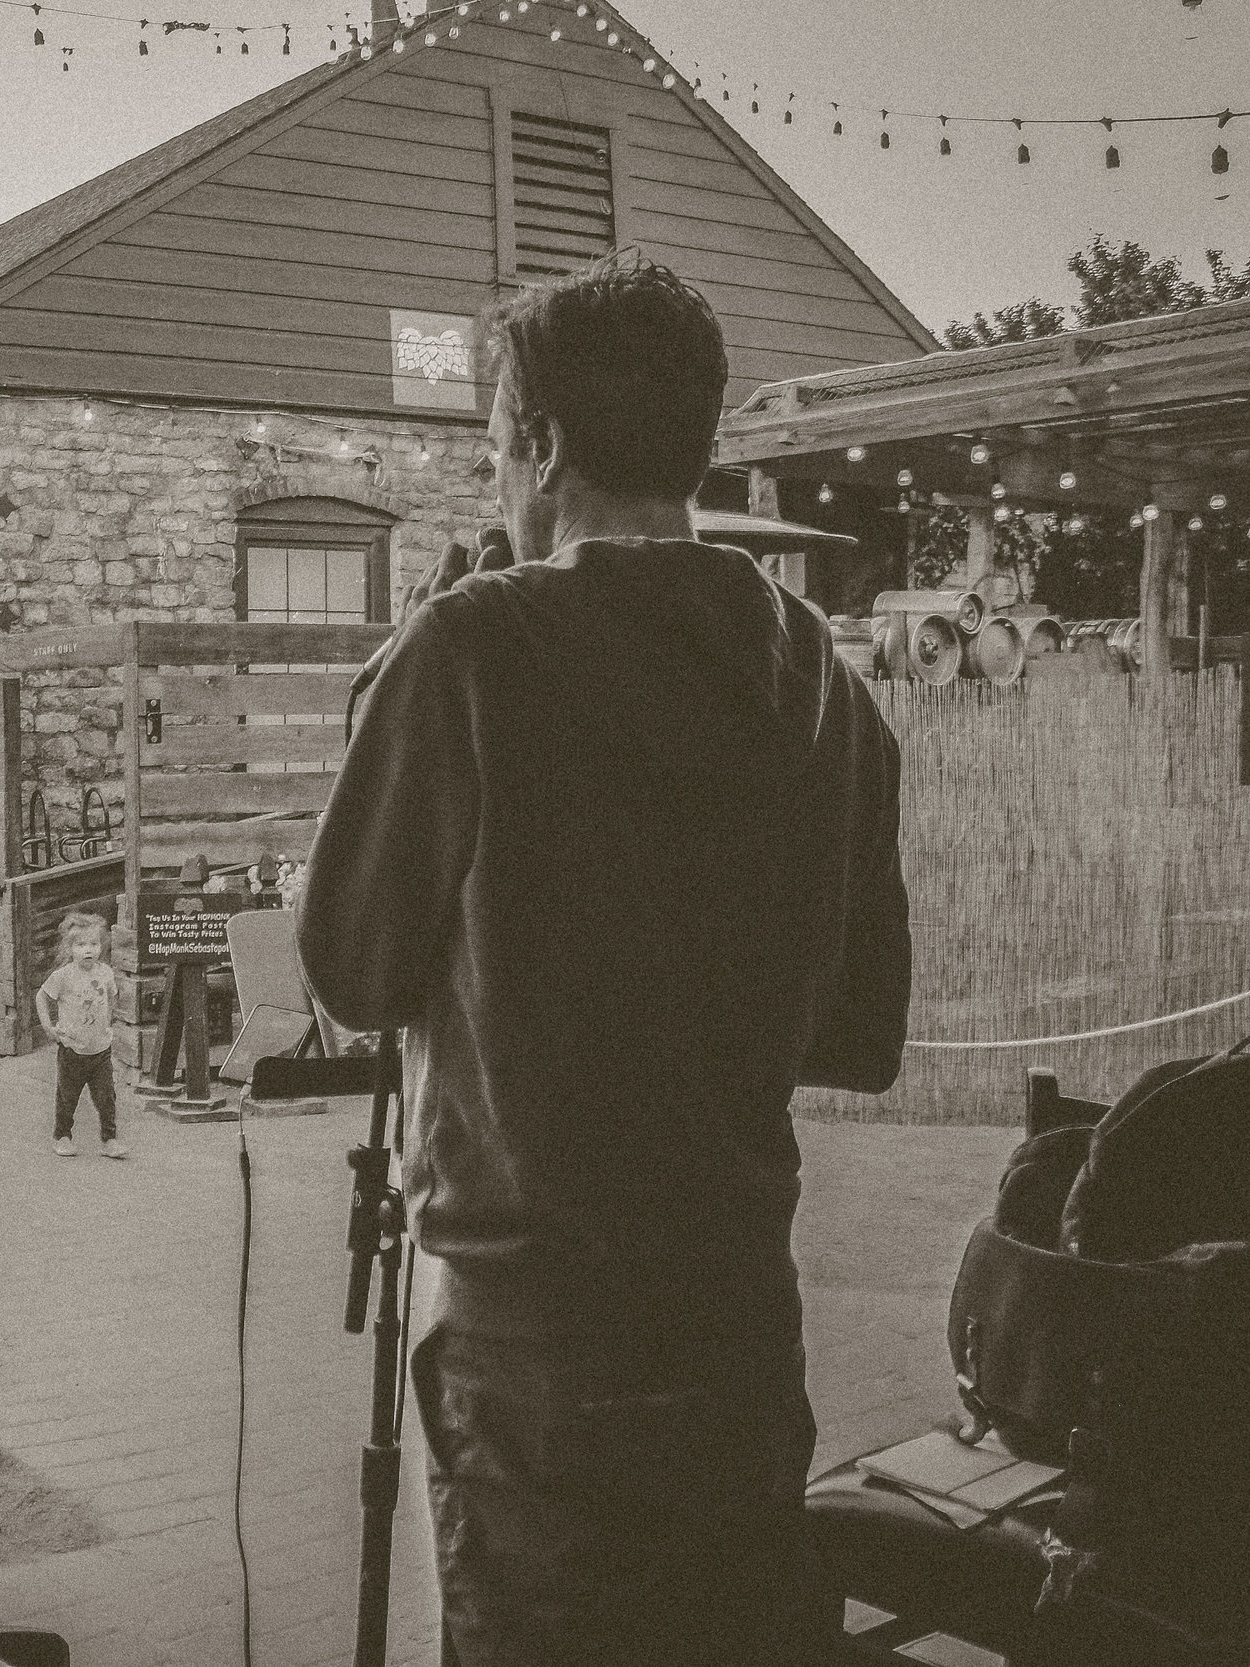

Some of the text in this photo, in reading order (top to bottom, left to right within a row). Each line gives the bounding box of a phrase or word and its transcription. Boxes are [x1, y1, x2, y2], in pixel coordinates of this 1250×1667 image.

[58, 641, 79, 655] ONLY
[161, 914, 171, 922] Us
[172, 914, 181, 922] In
[197, 913, 230, 921] HOPMONK
[149, 923, 198, 931] Instagram
[161, 930, 176, 938] Win
[178, 930, 199, 939] Tasty
[148, 943, 230, 956] @HopMonkSebastopol
